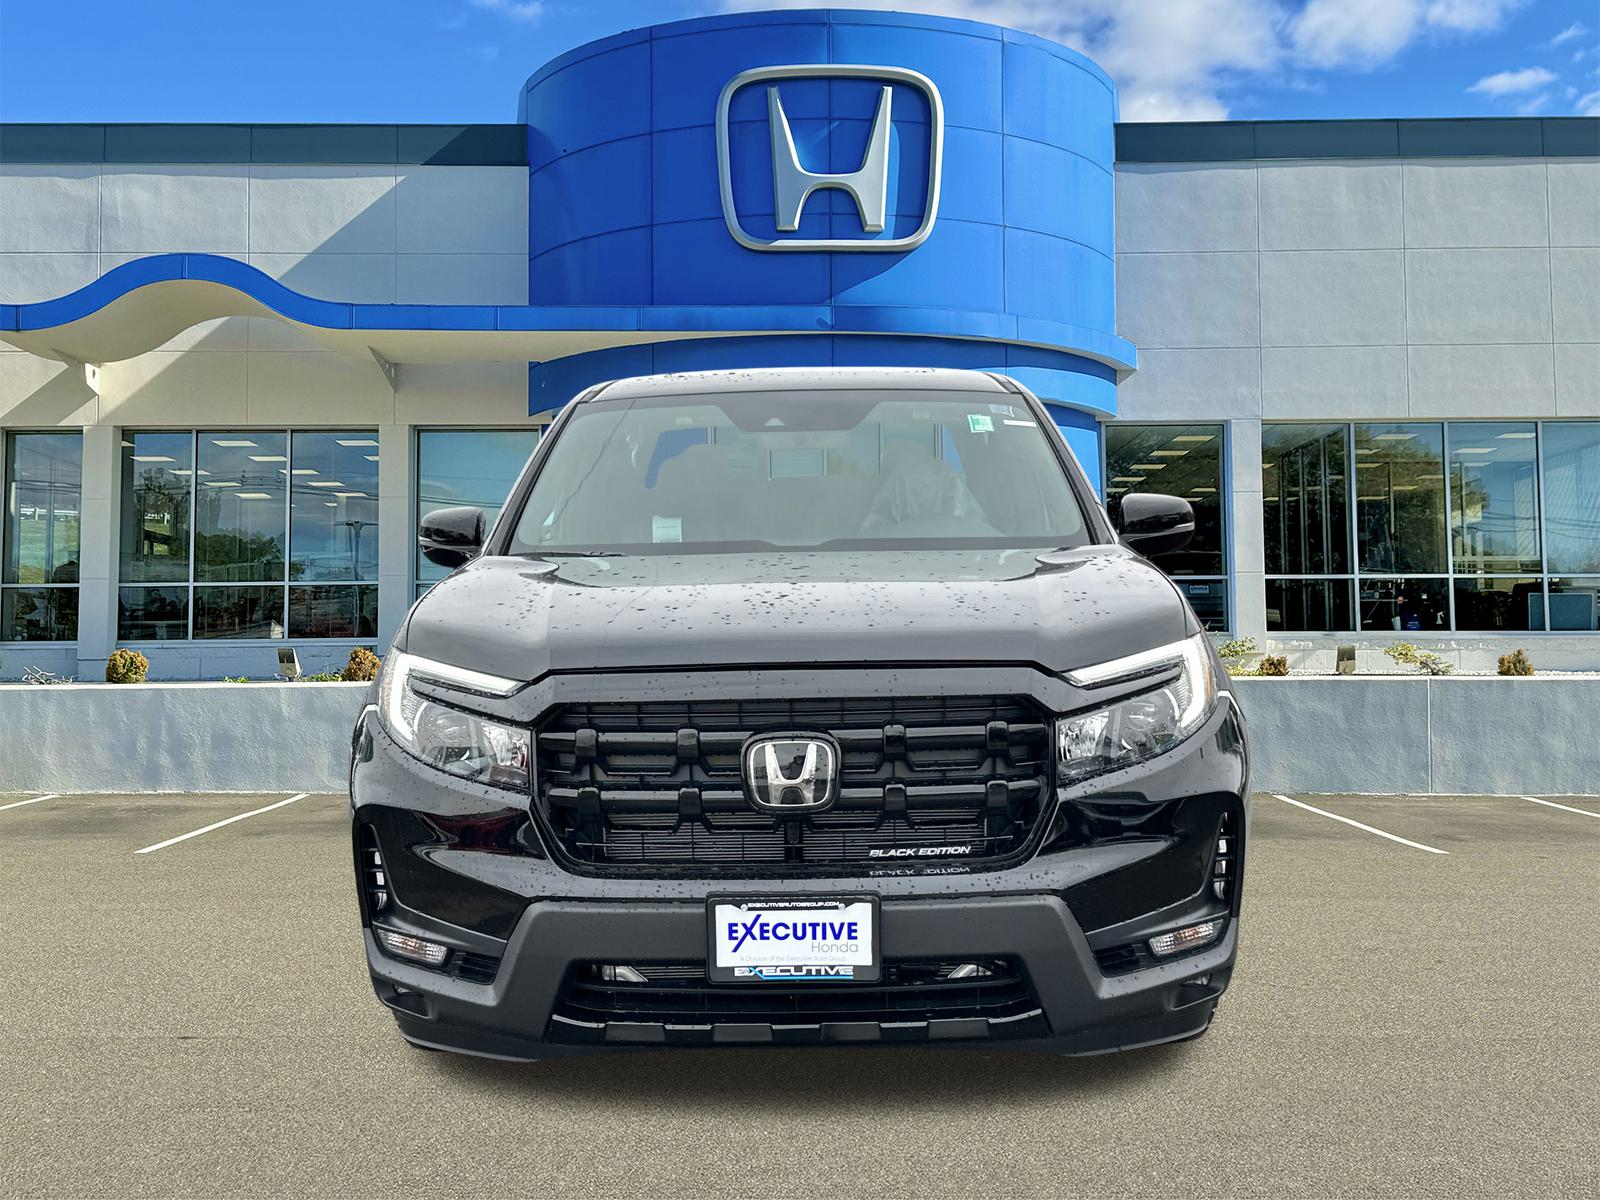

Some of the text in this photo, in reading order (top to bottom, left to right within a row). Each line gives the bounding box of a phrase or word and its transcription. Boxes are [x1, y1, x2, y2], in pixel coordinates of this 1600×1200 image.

[869, 846, 971, 857] BLACK EDITION
[728, 914, 858, 952] EXECUTIVE
[811, 942, 859, 953] Honda
[734, 966, 854, 979] EXECUTIVE
